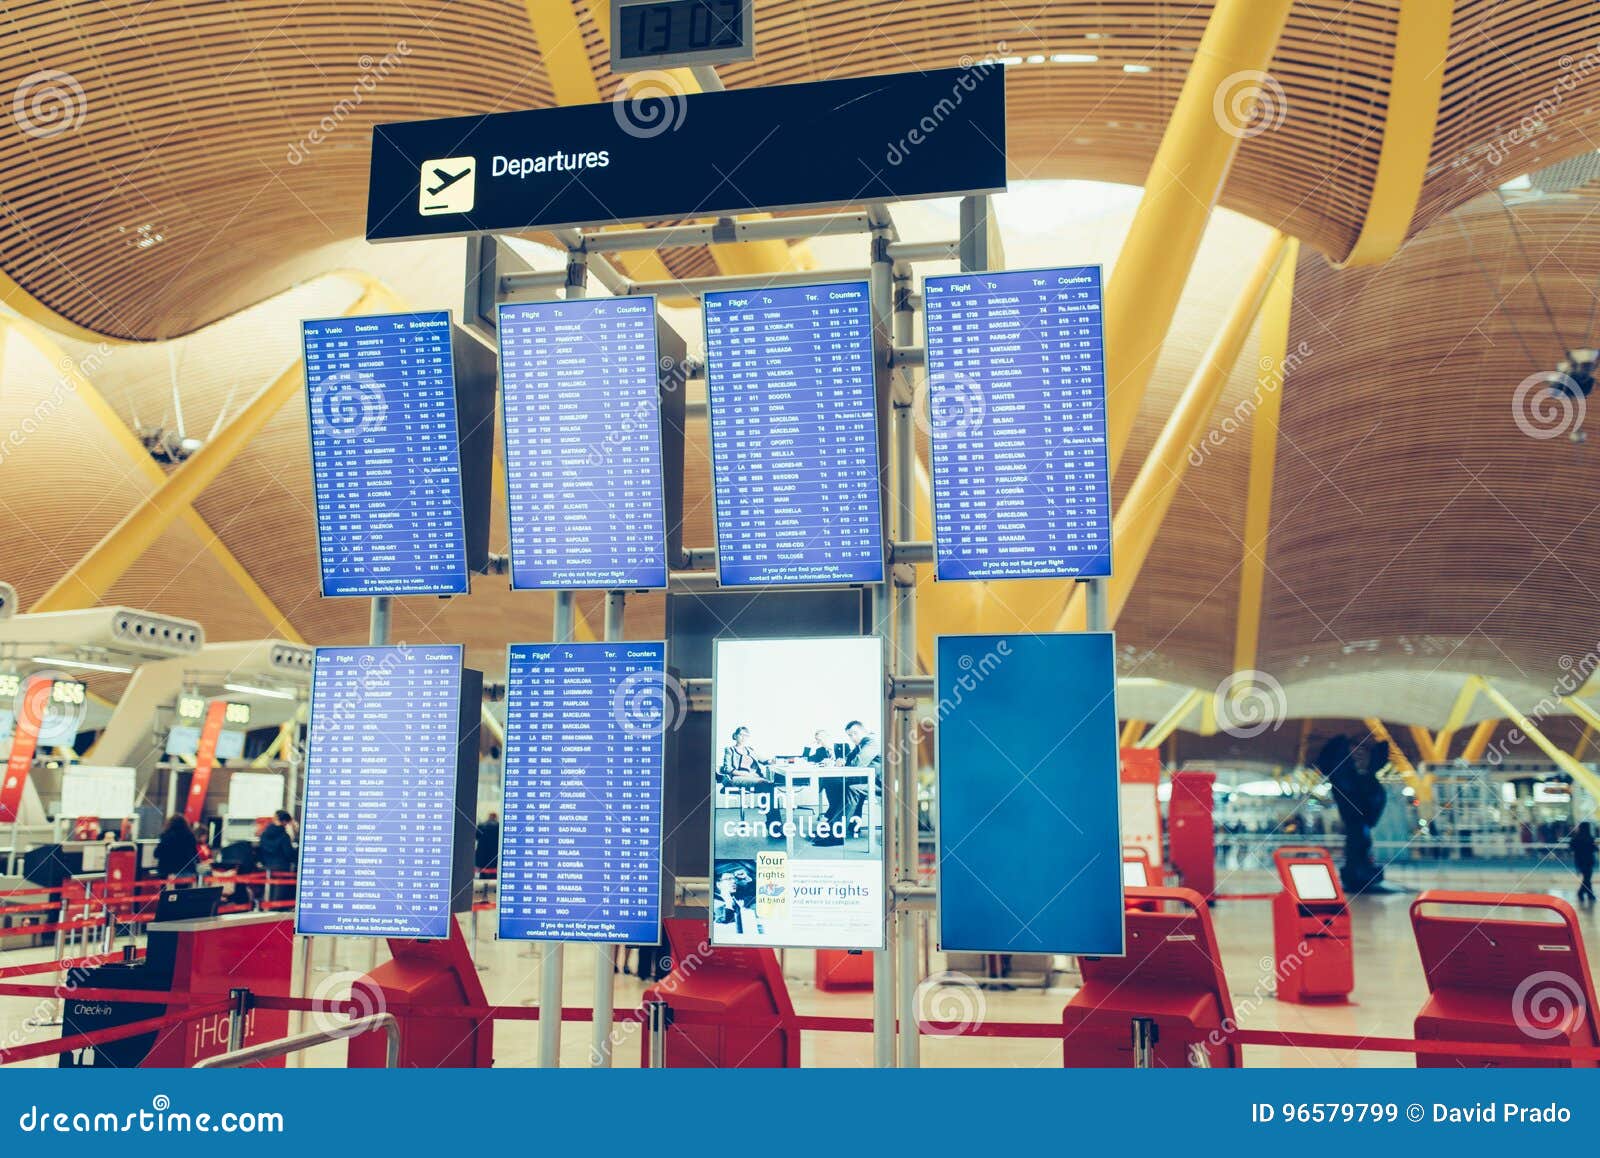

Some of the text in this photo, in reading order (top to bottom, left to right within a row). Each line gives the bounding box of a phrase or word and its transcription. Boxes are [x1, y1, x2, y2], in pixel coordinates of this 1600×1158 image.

[492, 147, 610, 179] Departures
[951, 284, 971, 292] Flight
[1058, 276, 1092, 285] Counters
[729, 299, 748, 307] Flight
[829, 291, 861, 300] Counters
[522, 311, 539, 320] Flight
[723, 815, 863, 838] cancelled?
[760, 856, 784, 865] Your
[758, 871, 785, 880] rights
[793, 885, 869, 898] your rights
[74, 1004, 112, 1015] Check-in
[194, 1008, 256, 1058] ¡Ho!
